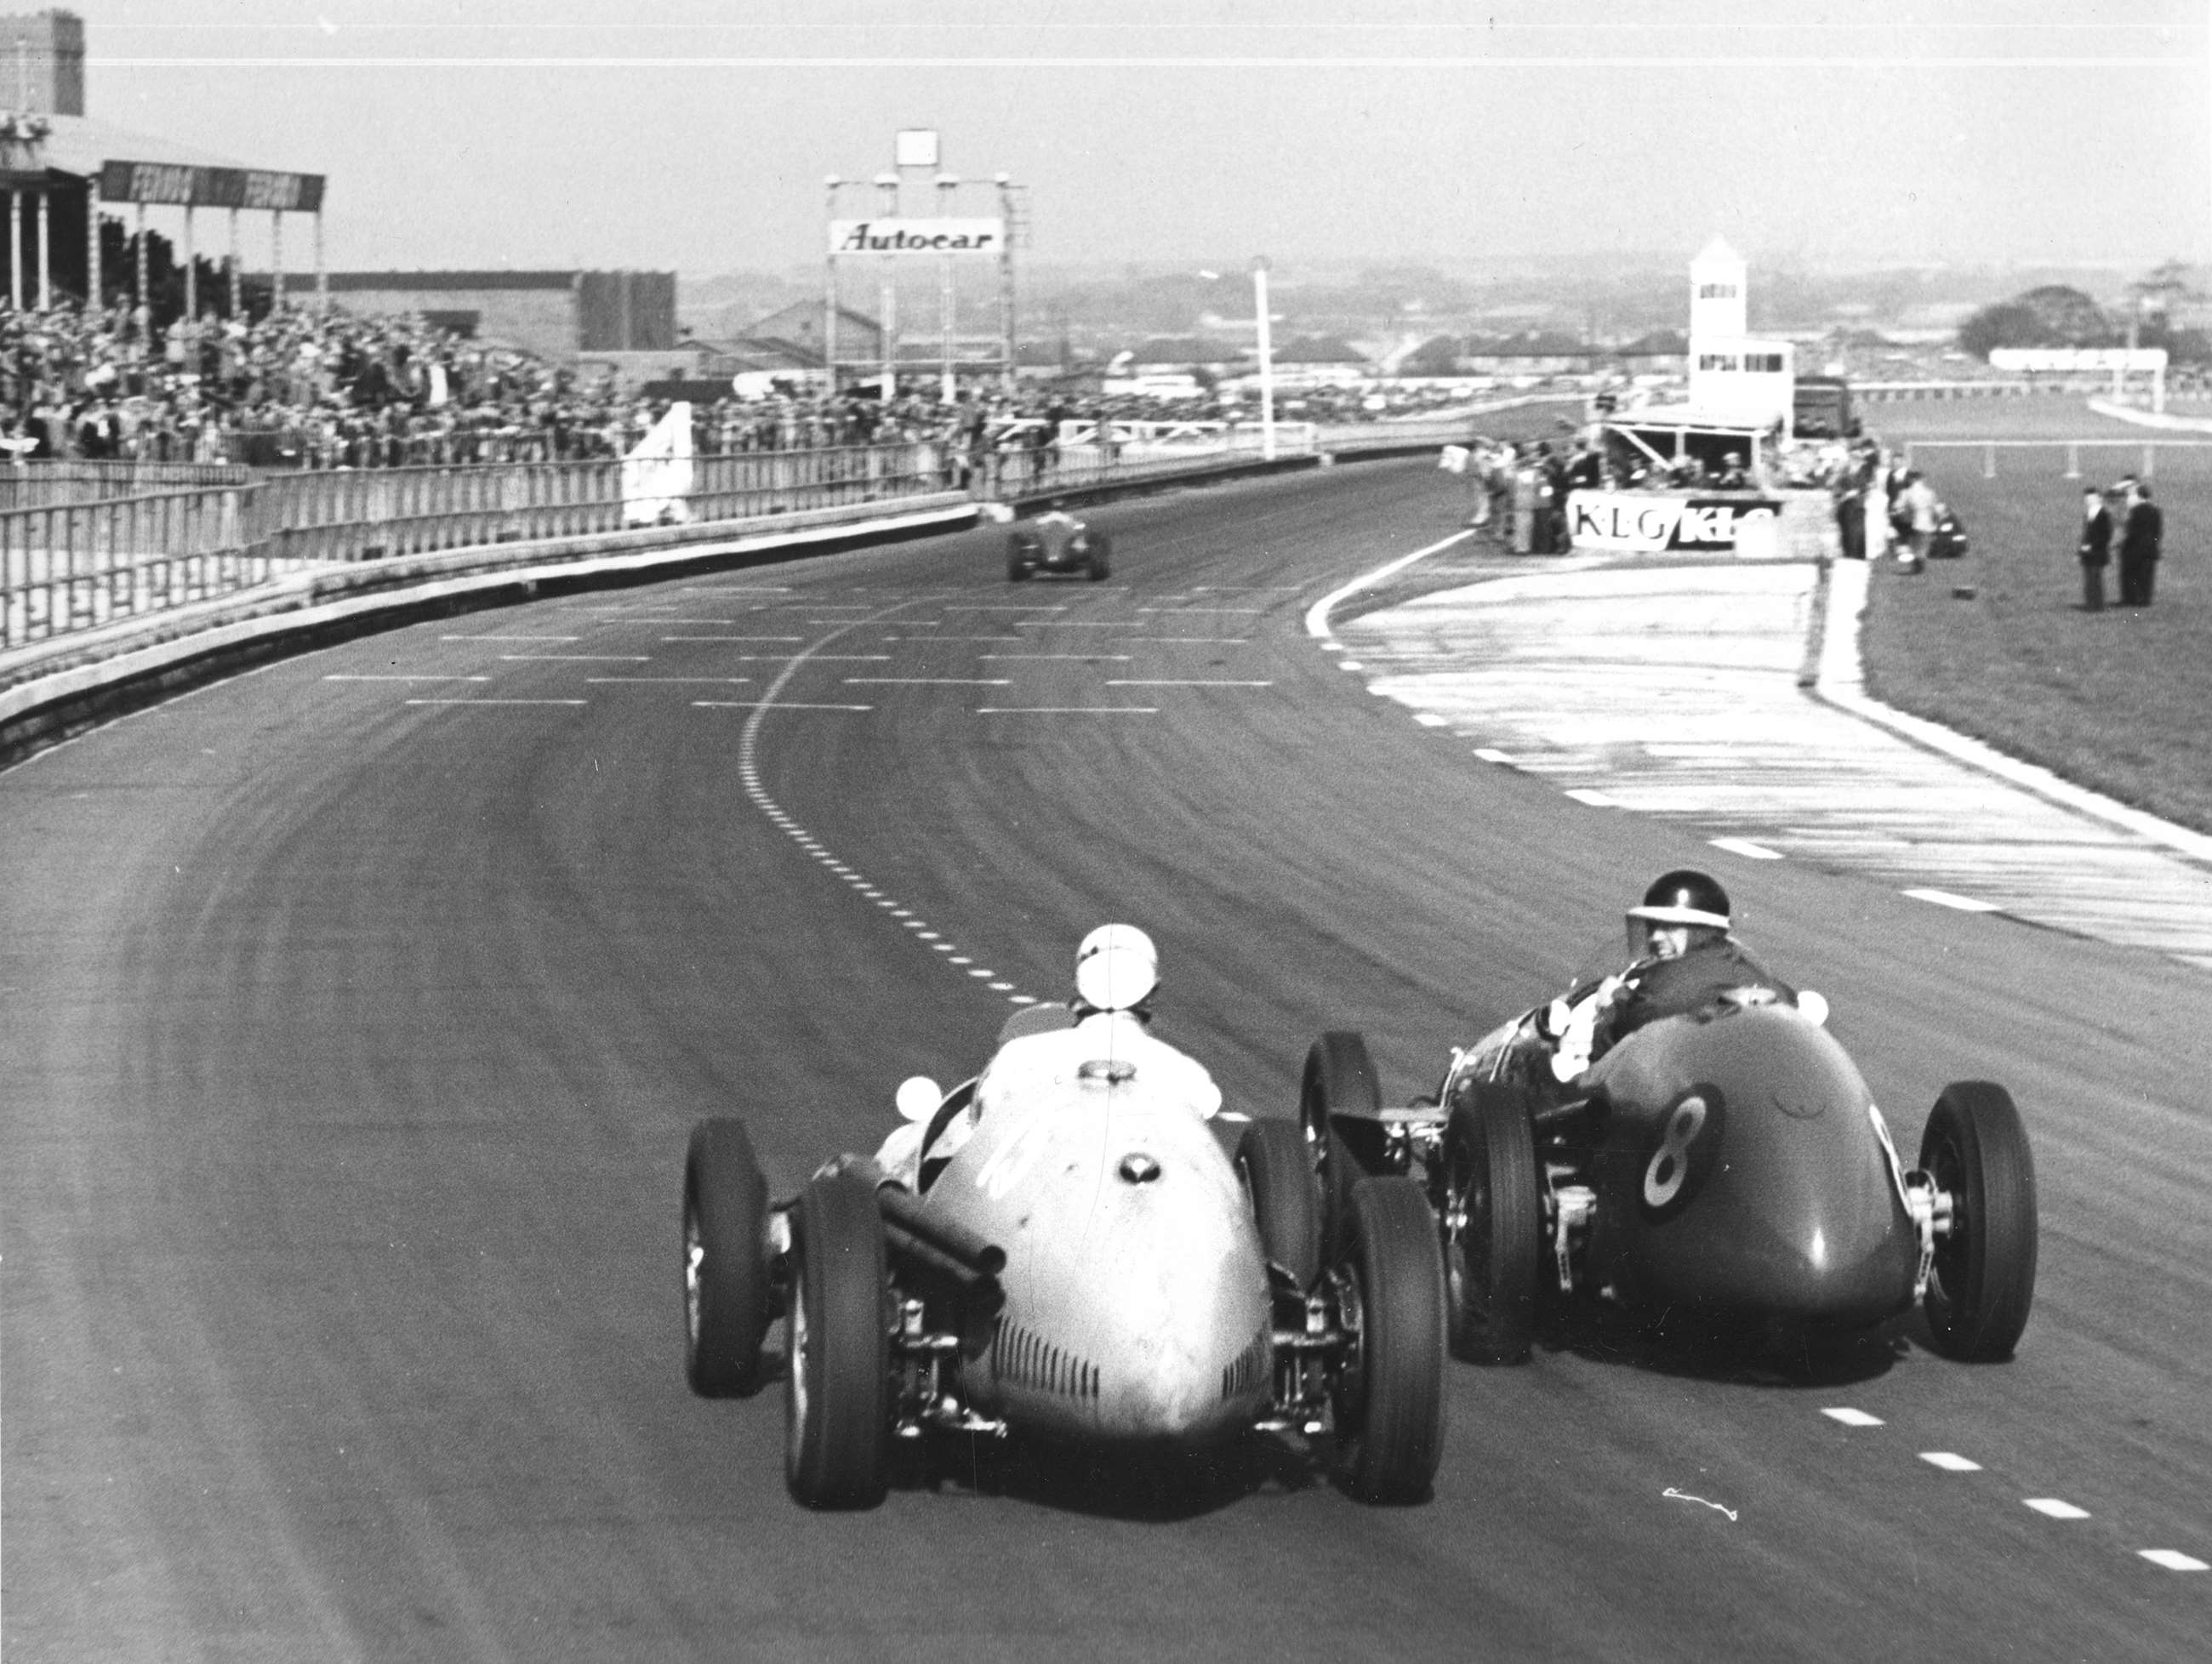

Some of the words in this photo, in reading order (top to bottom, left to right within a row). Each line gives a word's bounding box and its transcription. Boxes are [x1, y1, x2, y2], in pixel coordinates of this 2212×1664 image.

[840, 223, 993, 250] Autocar
[1679, 506, 1775, 543] KL
[1644, 1096, 1707, 1207] 8
